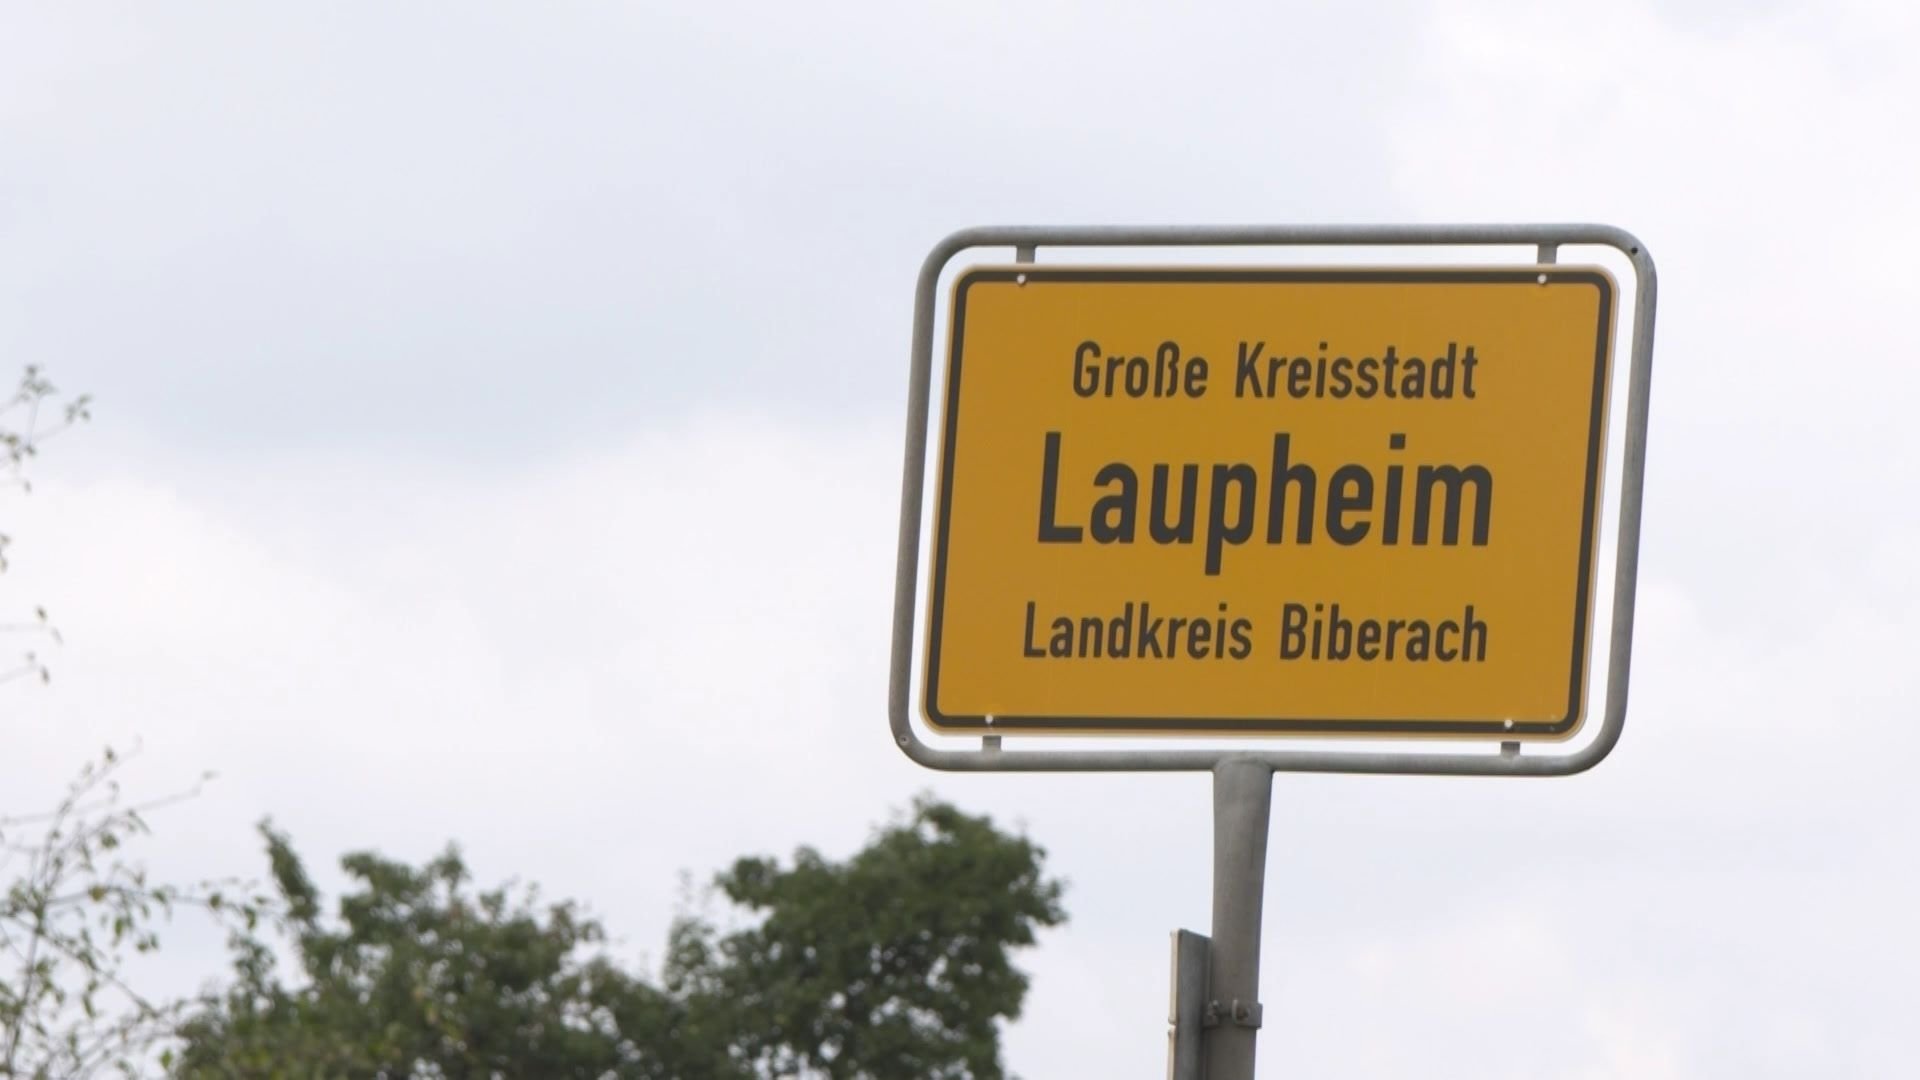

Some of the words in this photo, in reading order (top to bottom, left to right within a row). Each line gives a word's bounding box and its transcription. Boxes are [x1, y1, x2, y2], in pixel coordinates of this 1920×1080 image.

[1072, 340, 1209, 400] Große
[1234, 340, 1479, 401] Kreisstadt
[1036, 430, 1494, 578] Laupheim
[1022, 599, 1253, 662] Landkreis
[1278, 602, 1489, 664] Biberach
